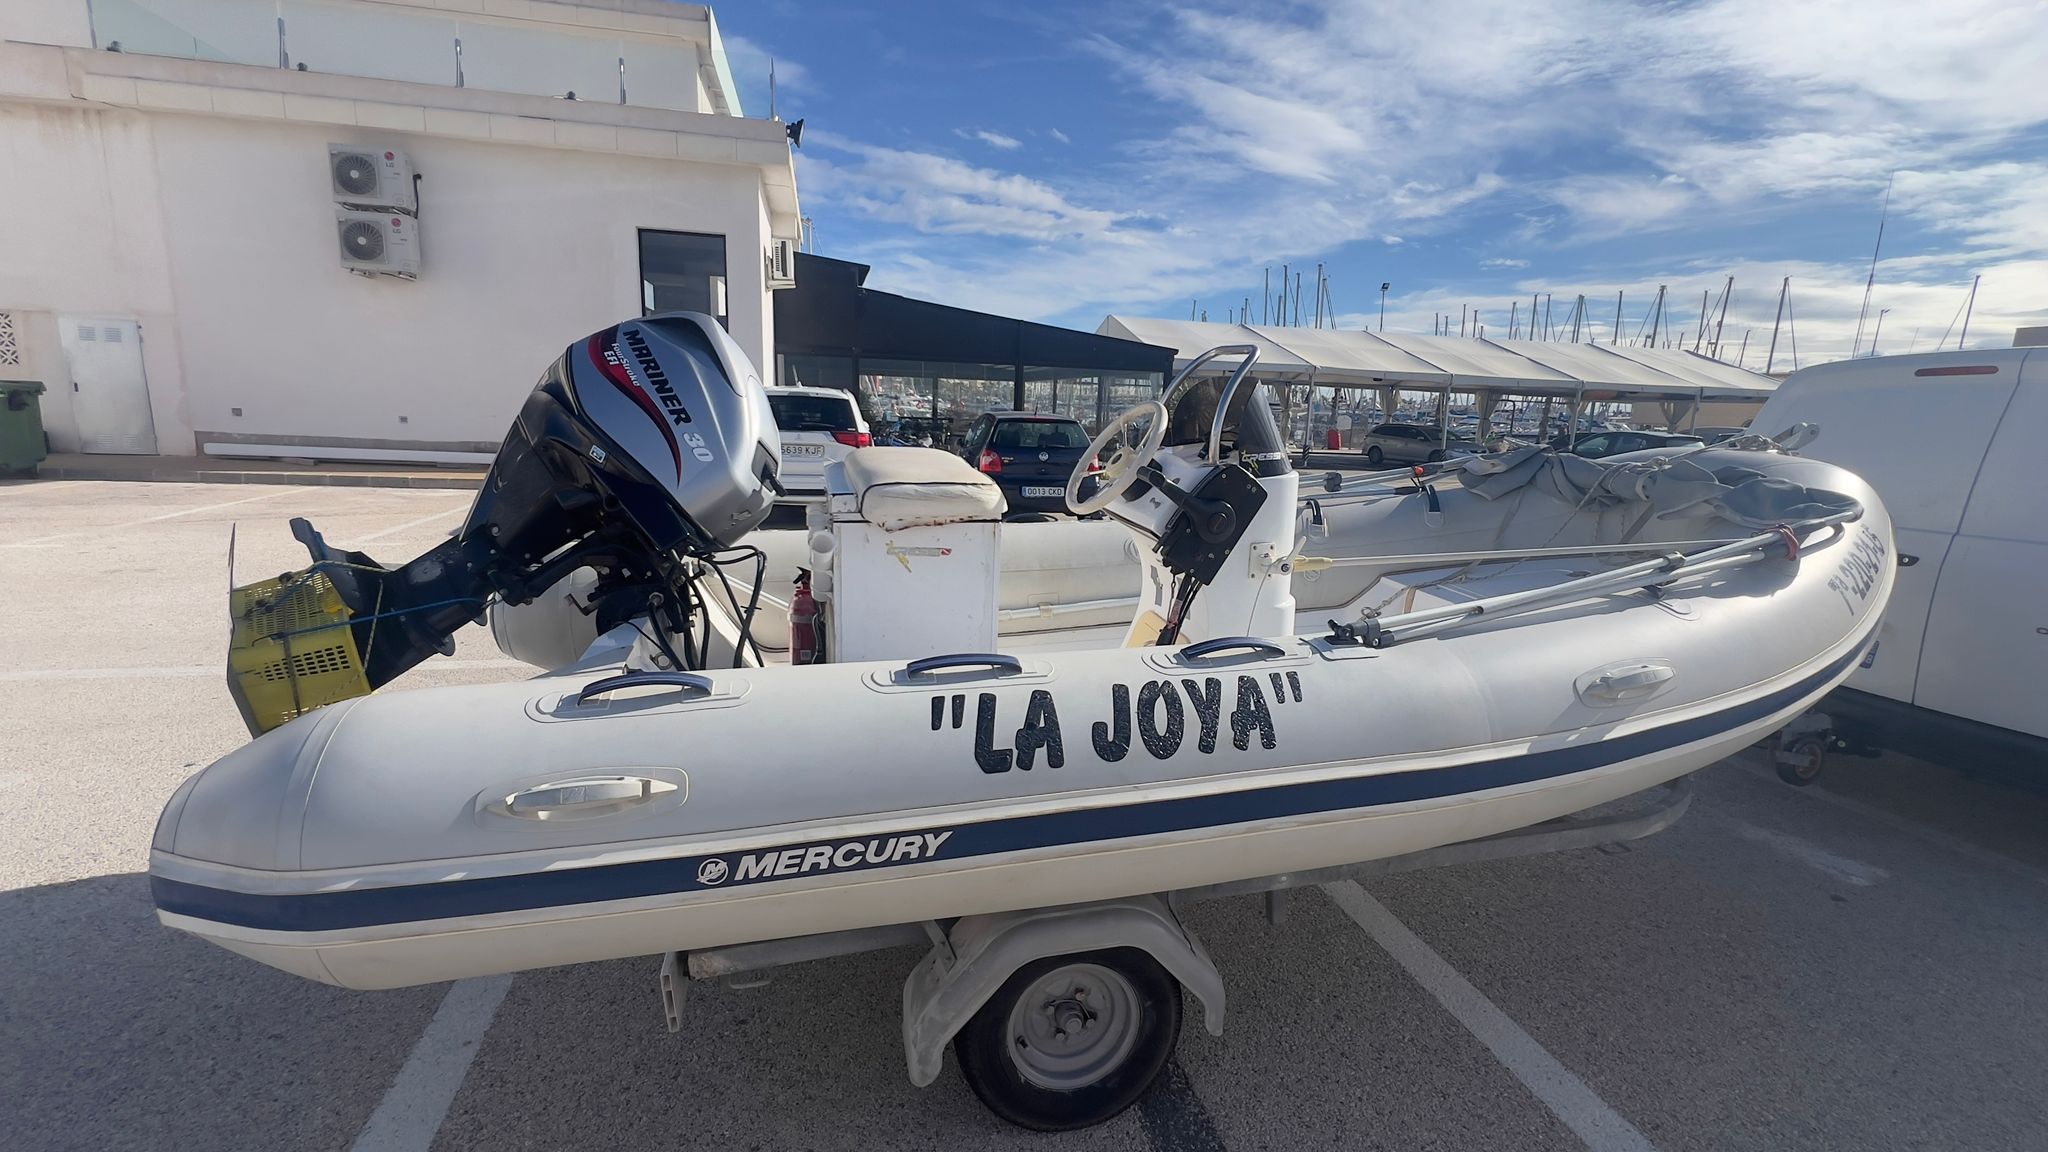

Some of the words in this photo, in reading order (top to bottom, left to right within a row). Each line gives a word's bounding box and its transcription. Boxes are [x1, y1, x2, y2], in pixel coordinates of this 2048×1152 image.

[603, 350, 620, 366] EFI
[611, 342, 640, 387] FourStroke
[623, 329, 692, 426] MARINER
[683, 432, 714, 462] 30
[781, 446, 804, 454] 5639
[805, 446, 822, 455] KJF
[1027, 487, 1046, 495] 0013
[931, 689, 1065, 774] "LA
[1091, 671, 1303, 763] JOYA"
[734, 831, 954, 881] MERCURY
